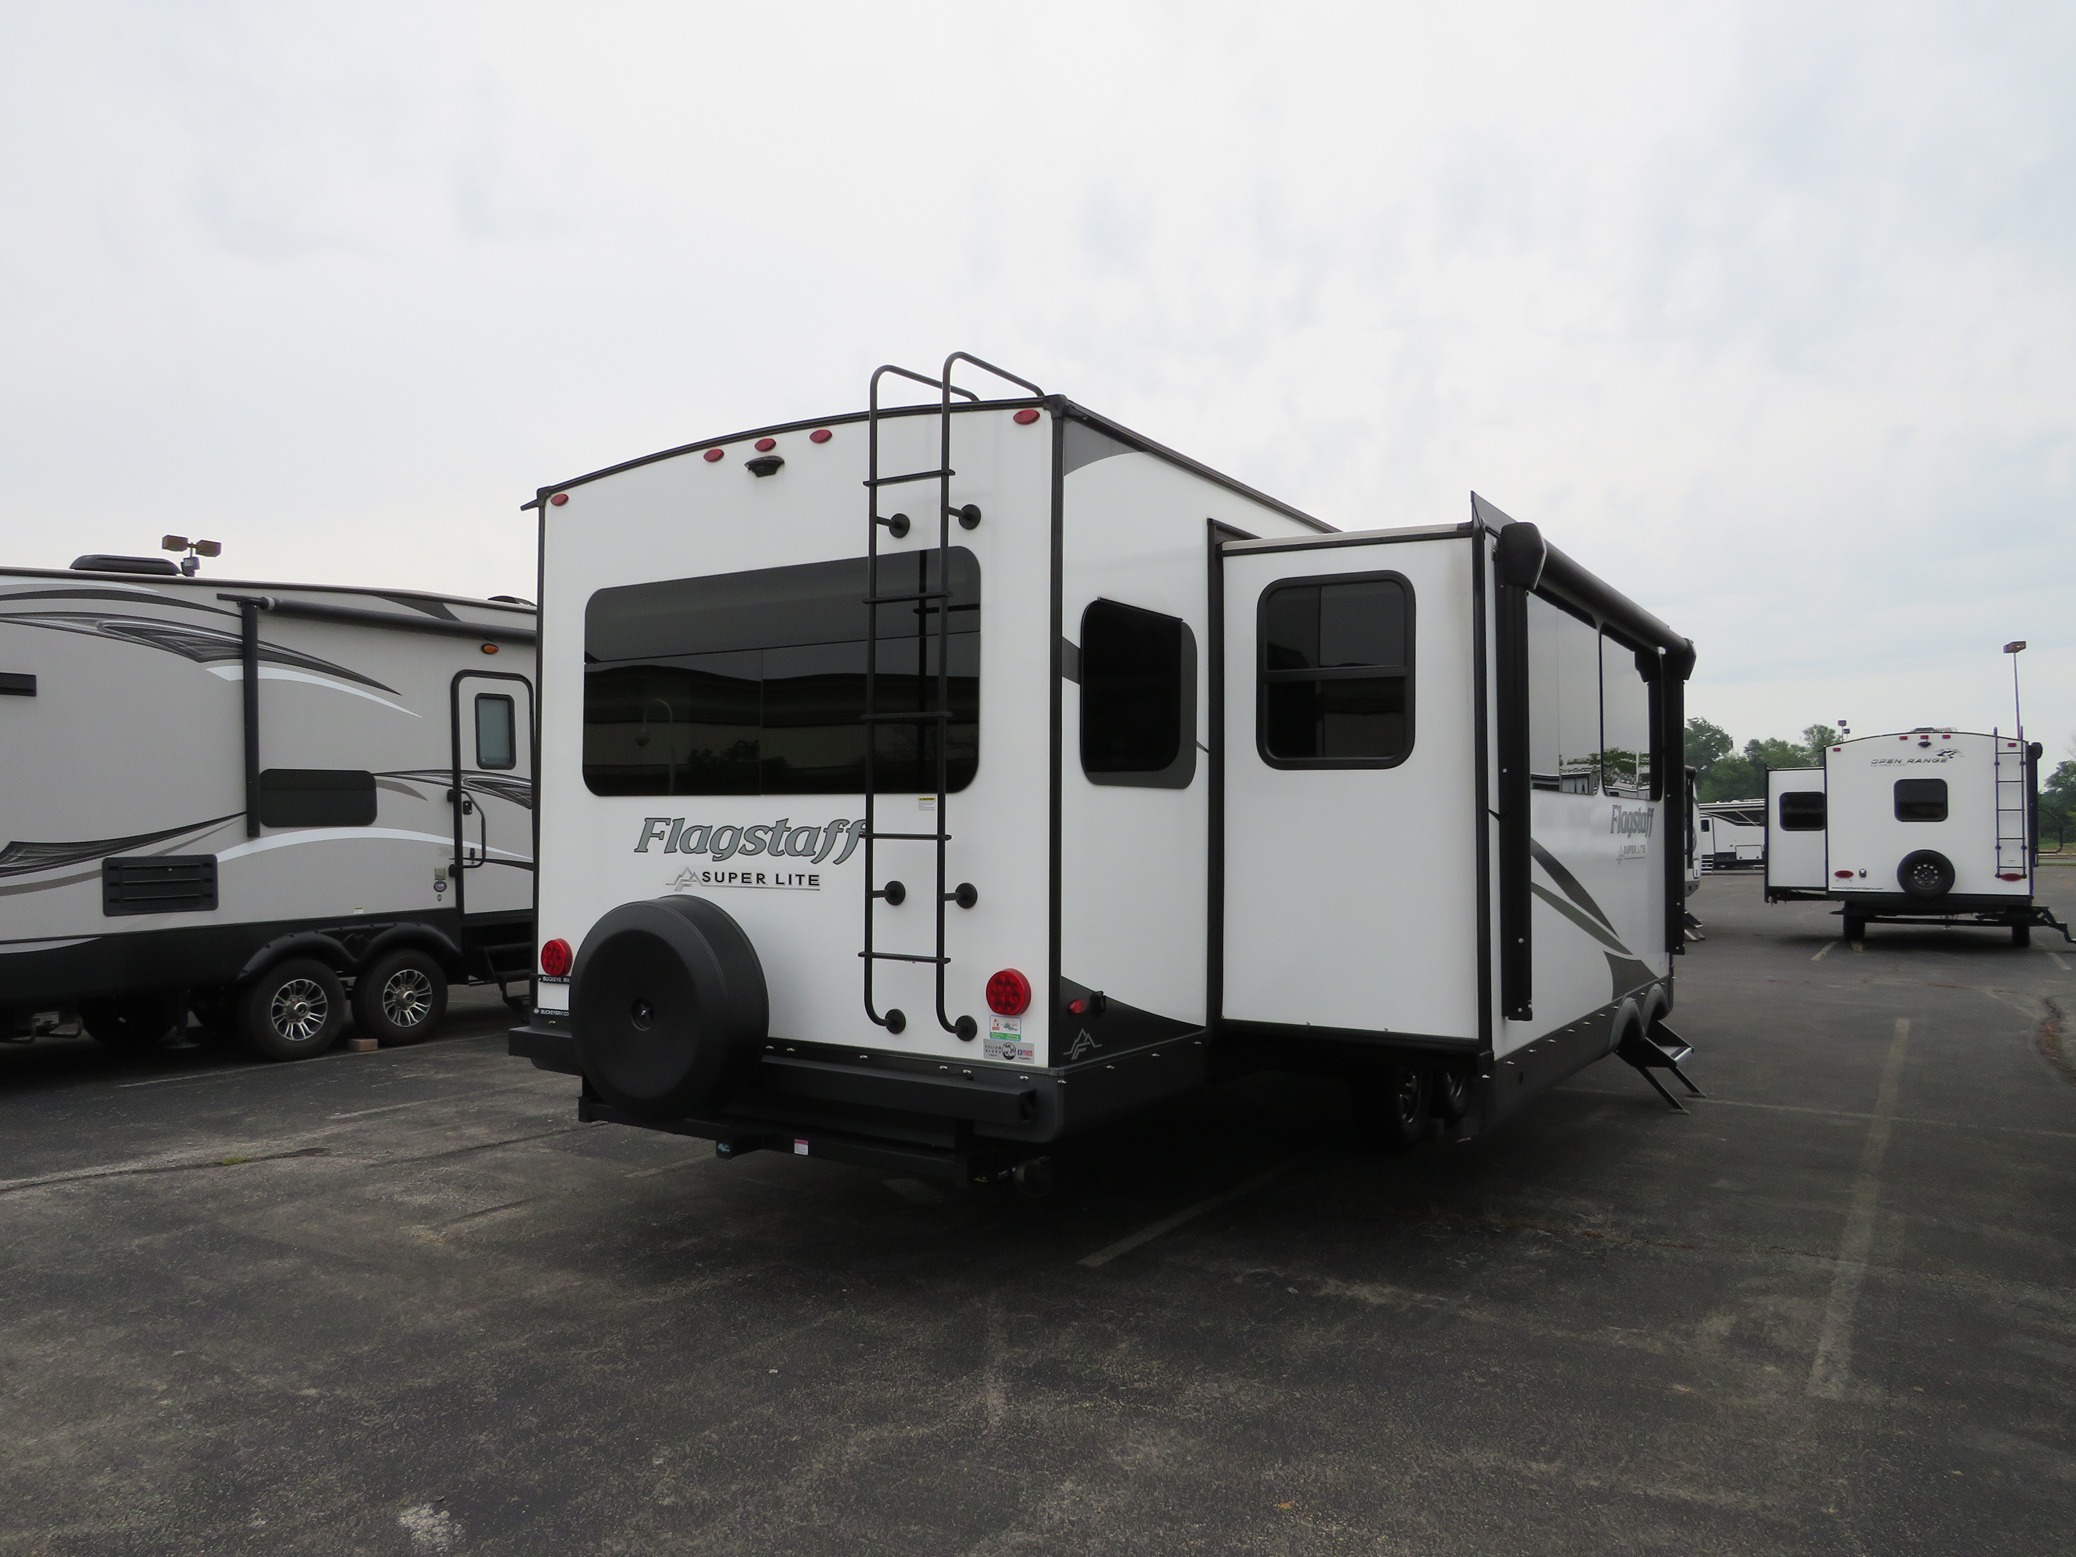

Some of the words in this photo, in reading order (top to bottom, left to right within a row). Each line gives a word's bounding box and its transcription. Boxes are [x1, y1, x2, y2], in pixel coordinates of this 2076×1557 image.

[1610, 804, 1655, 839] Flagstaff
[633, 817, 867, 865] Flagstaff
[701, 870, 767, 885] SUPER
[775, 873, 820, 886] LITE
